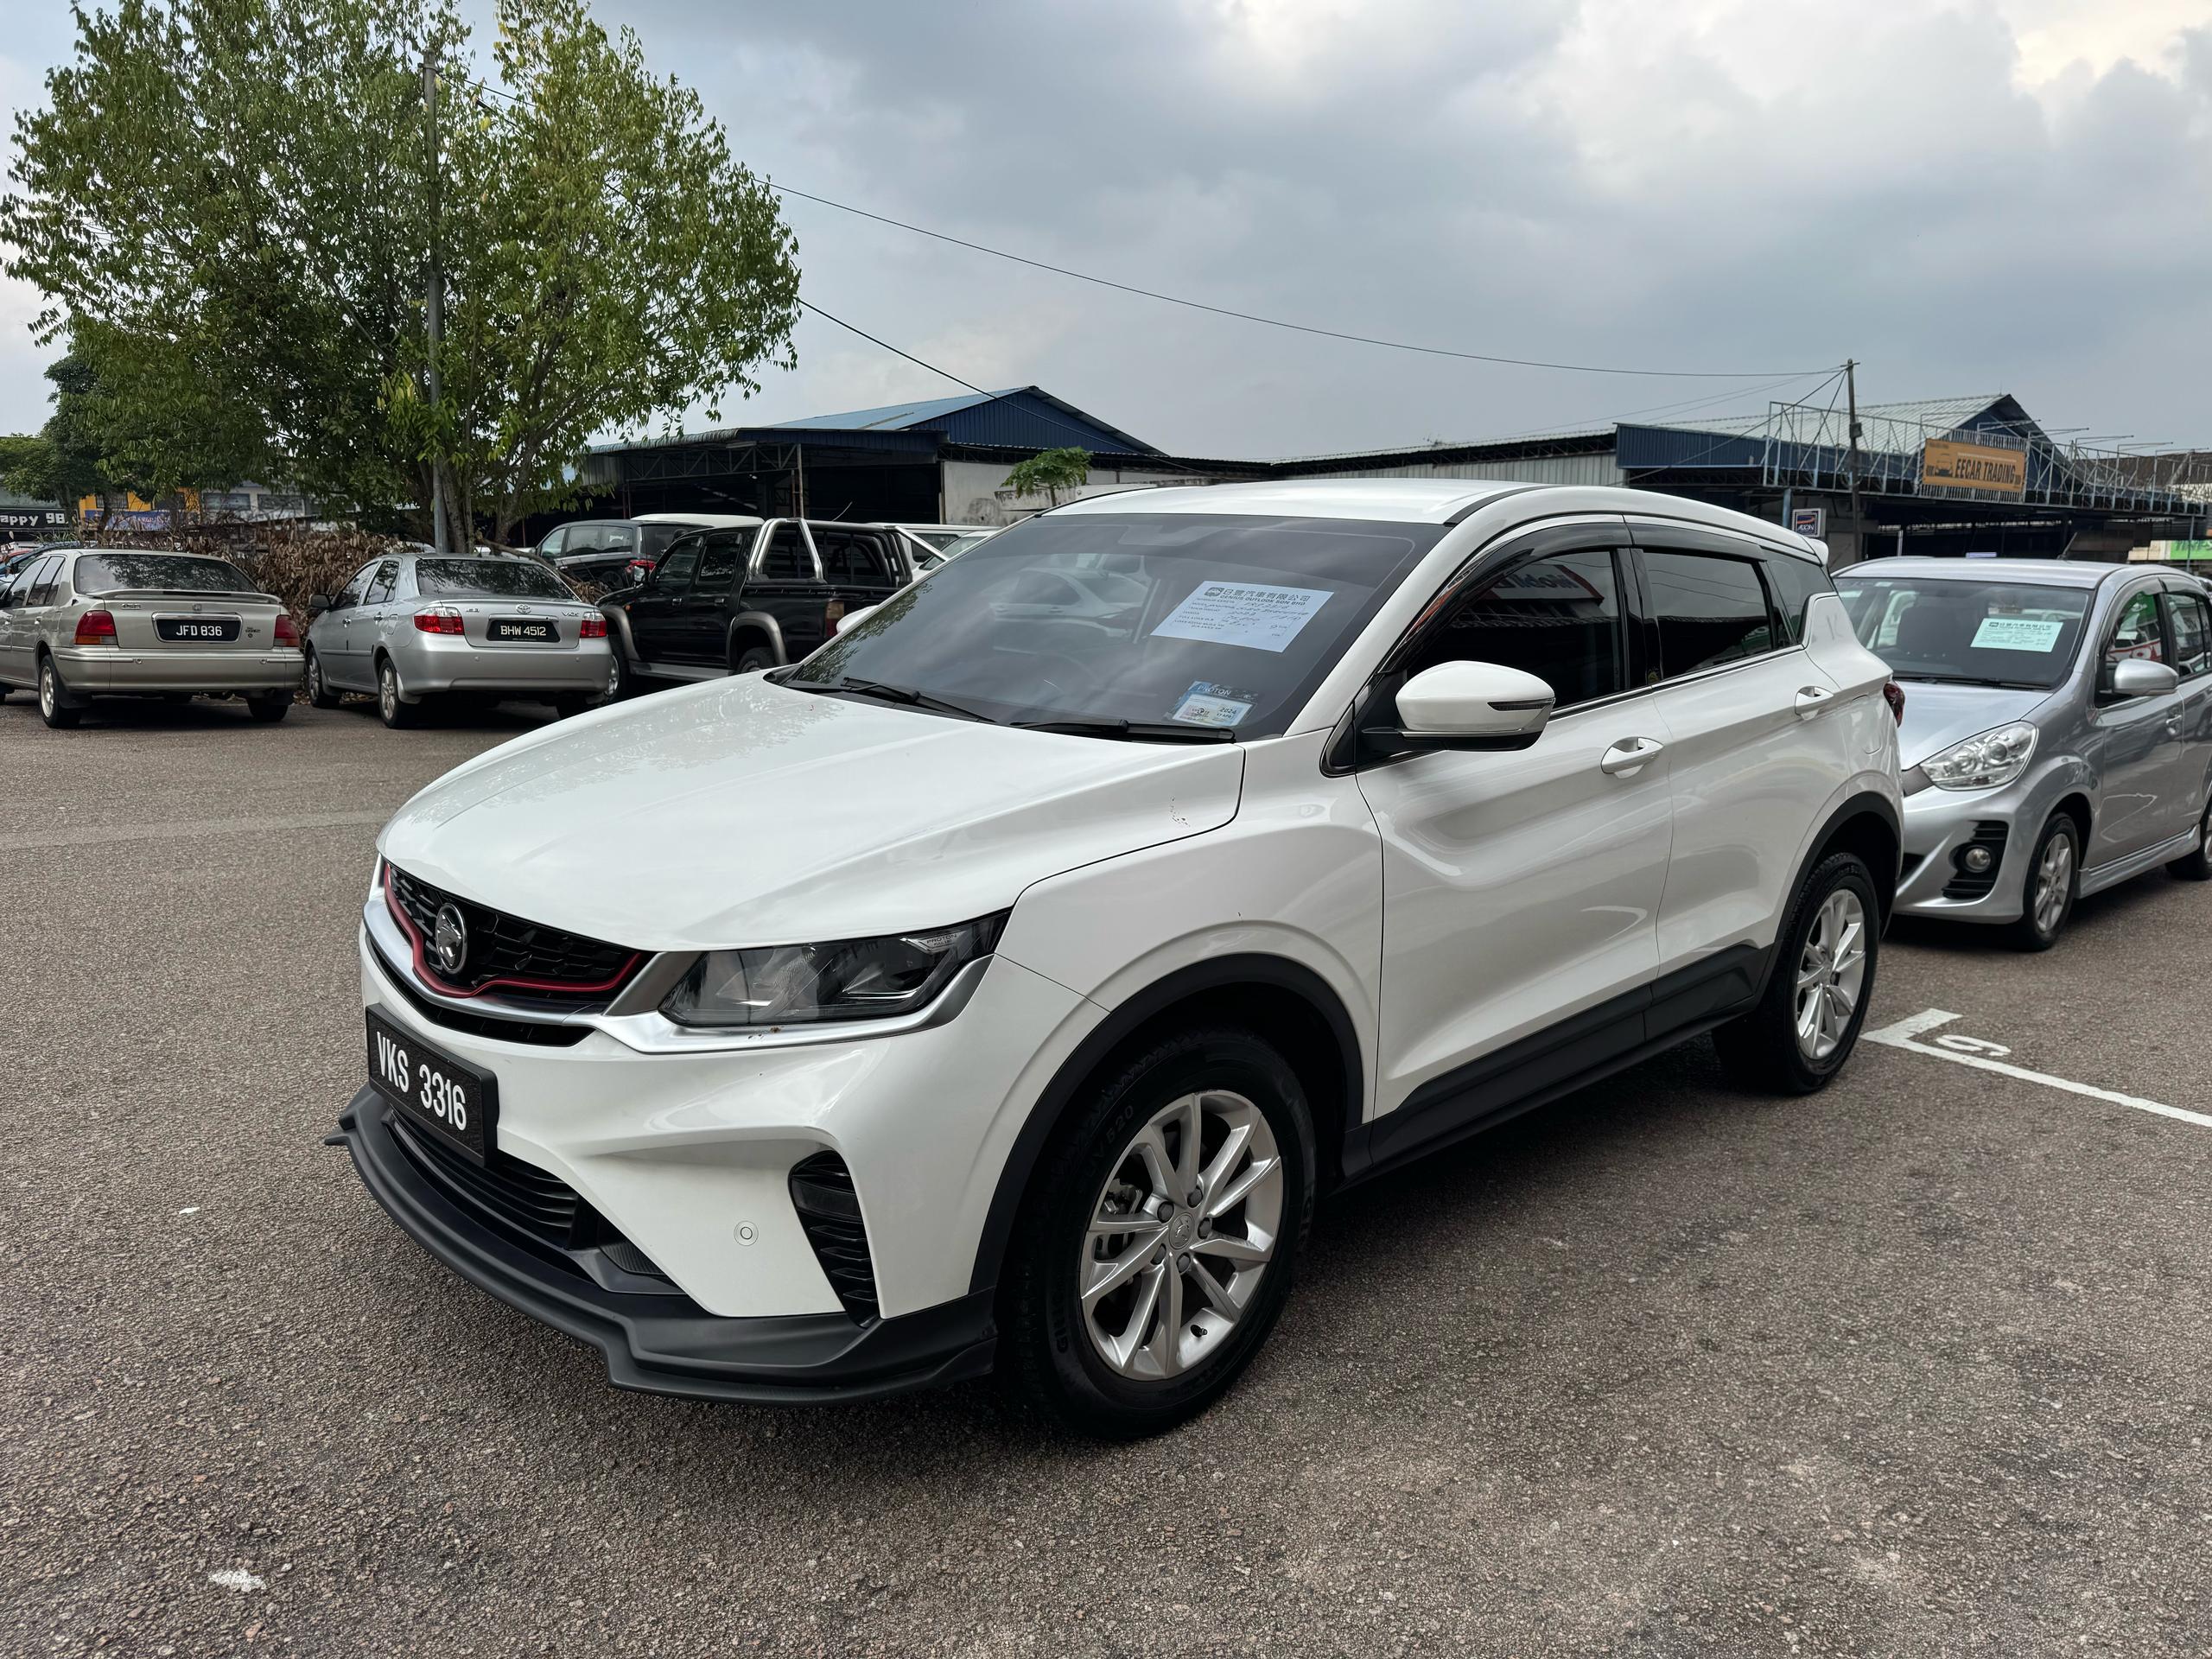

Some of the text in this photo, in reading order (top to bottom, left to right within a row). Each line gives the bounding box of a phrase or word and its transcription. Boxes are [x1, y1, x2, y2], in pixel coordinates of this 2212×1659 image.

[1955, 459, 1981, 480] EECAR
[1983, 461, 2016, 484] TRADING
[0, 514, 39, 526] appy
[175, 625, 222, 636] JFD 836
[500, 625, 546, 636] BHW 4512
[1198, 685, 1231, 696] PROTON
[926, 934, 957, 944] PROTON
[377, 1031, 467, 1131] VKS 3316
